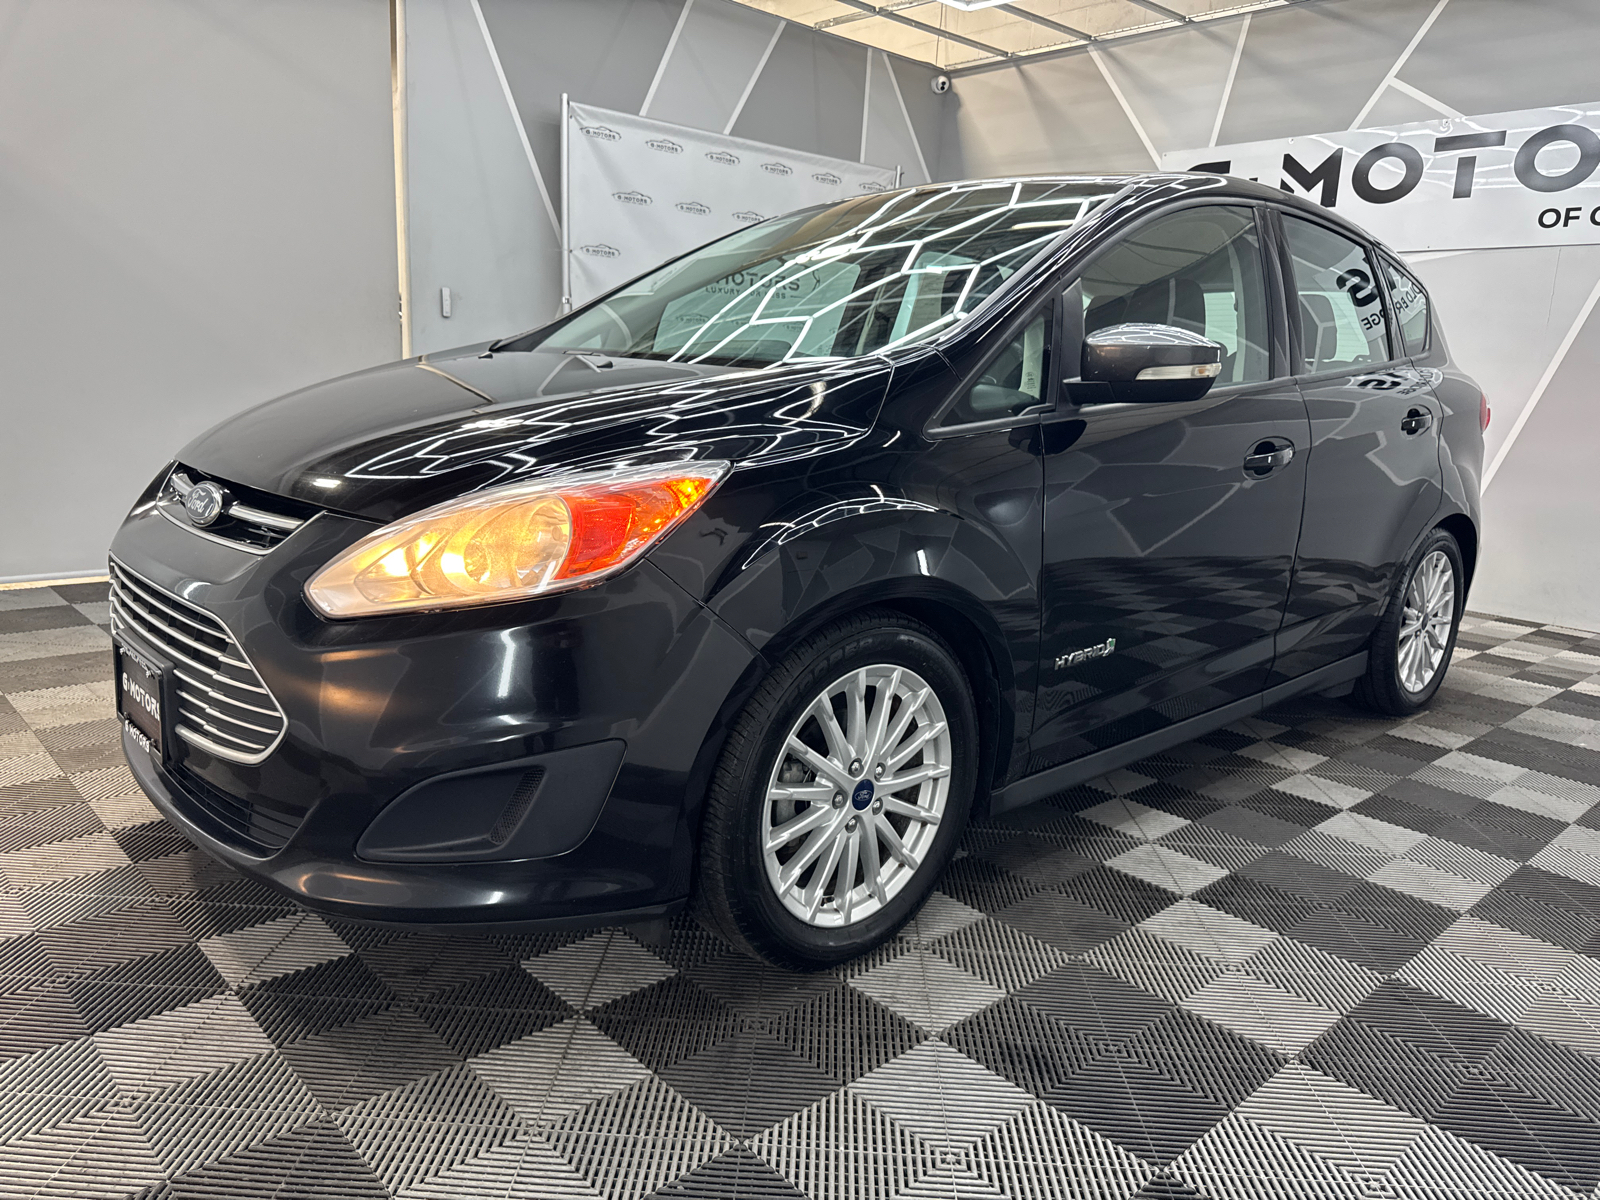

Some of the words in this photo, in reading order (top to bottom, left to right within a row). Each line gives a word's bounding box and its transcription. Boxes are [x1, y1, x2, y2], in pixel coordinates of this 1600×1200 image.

[592, 131, 616, 140] MOTORS
[656, 144, 678, 153] MOTORS
[623, 196, 647, 204] MOTORS
[1537, 206, 1583, 229] OF
[705, 286, 740, 295] LUXURY
[188, 488, 207, 514] Ford
[1054, 643, 1106, 670] HYBRID
